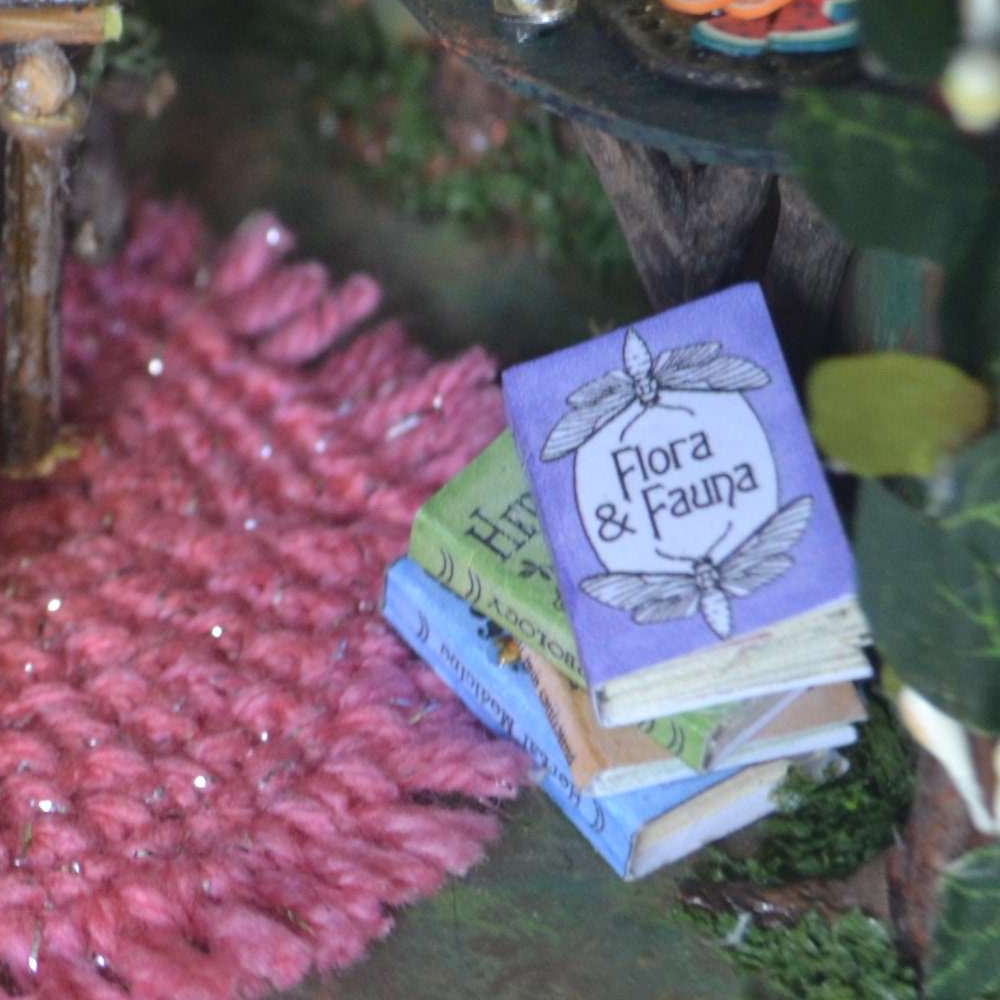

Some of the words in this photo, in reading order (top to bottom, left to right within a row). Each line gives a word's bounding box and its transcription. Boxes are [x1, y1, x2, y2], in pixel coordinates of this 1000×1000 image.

[595, 503, 637, 542] &
[641, 462, 759, 541] Fauna
[611, 430, 713, 502] Flora
